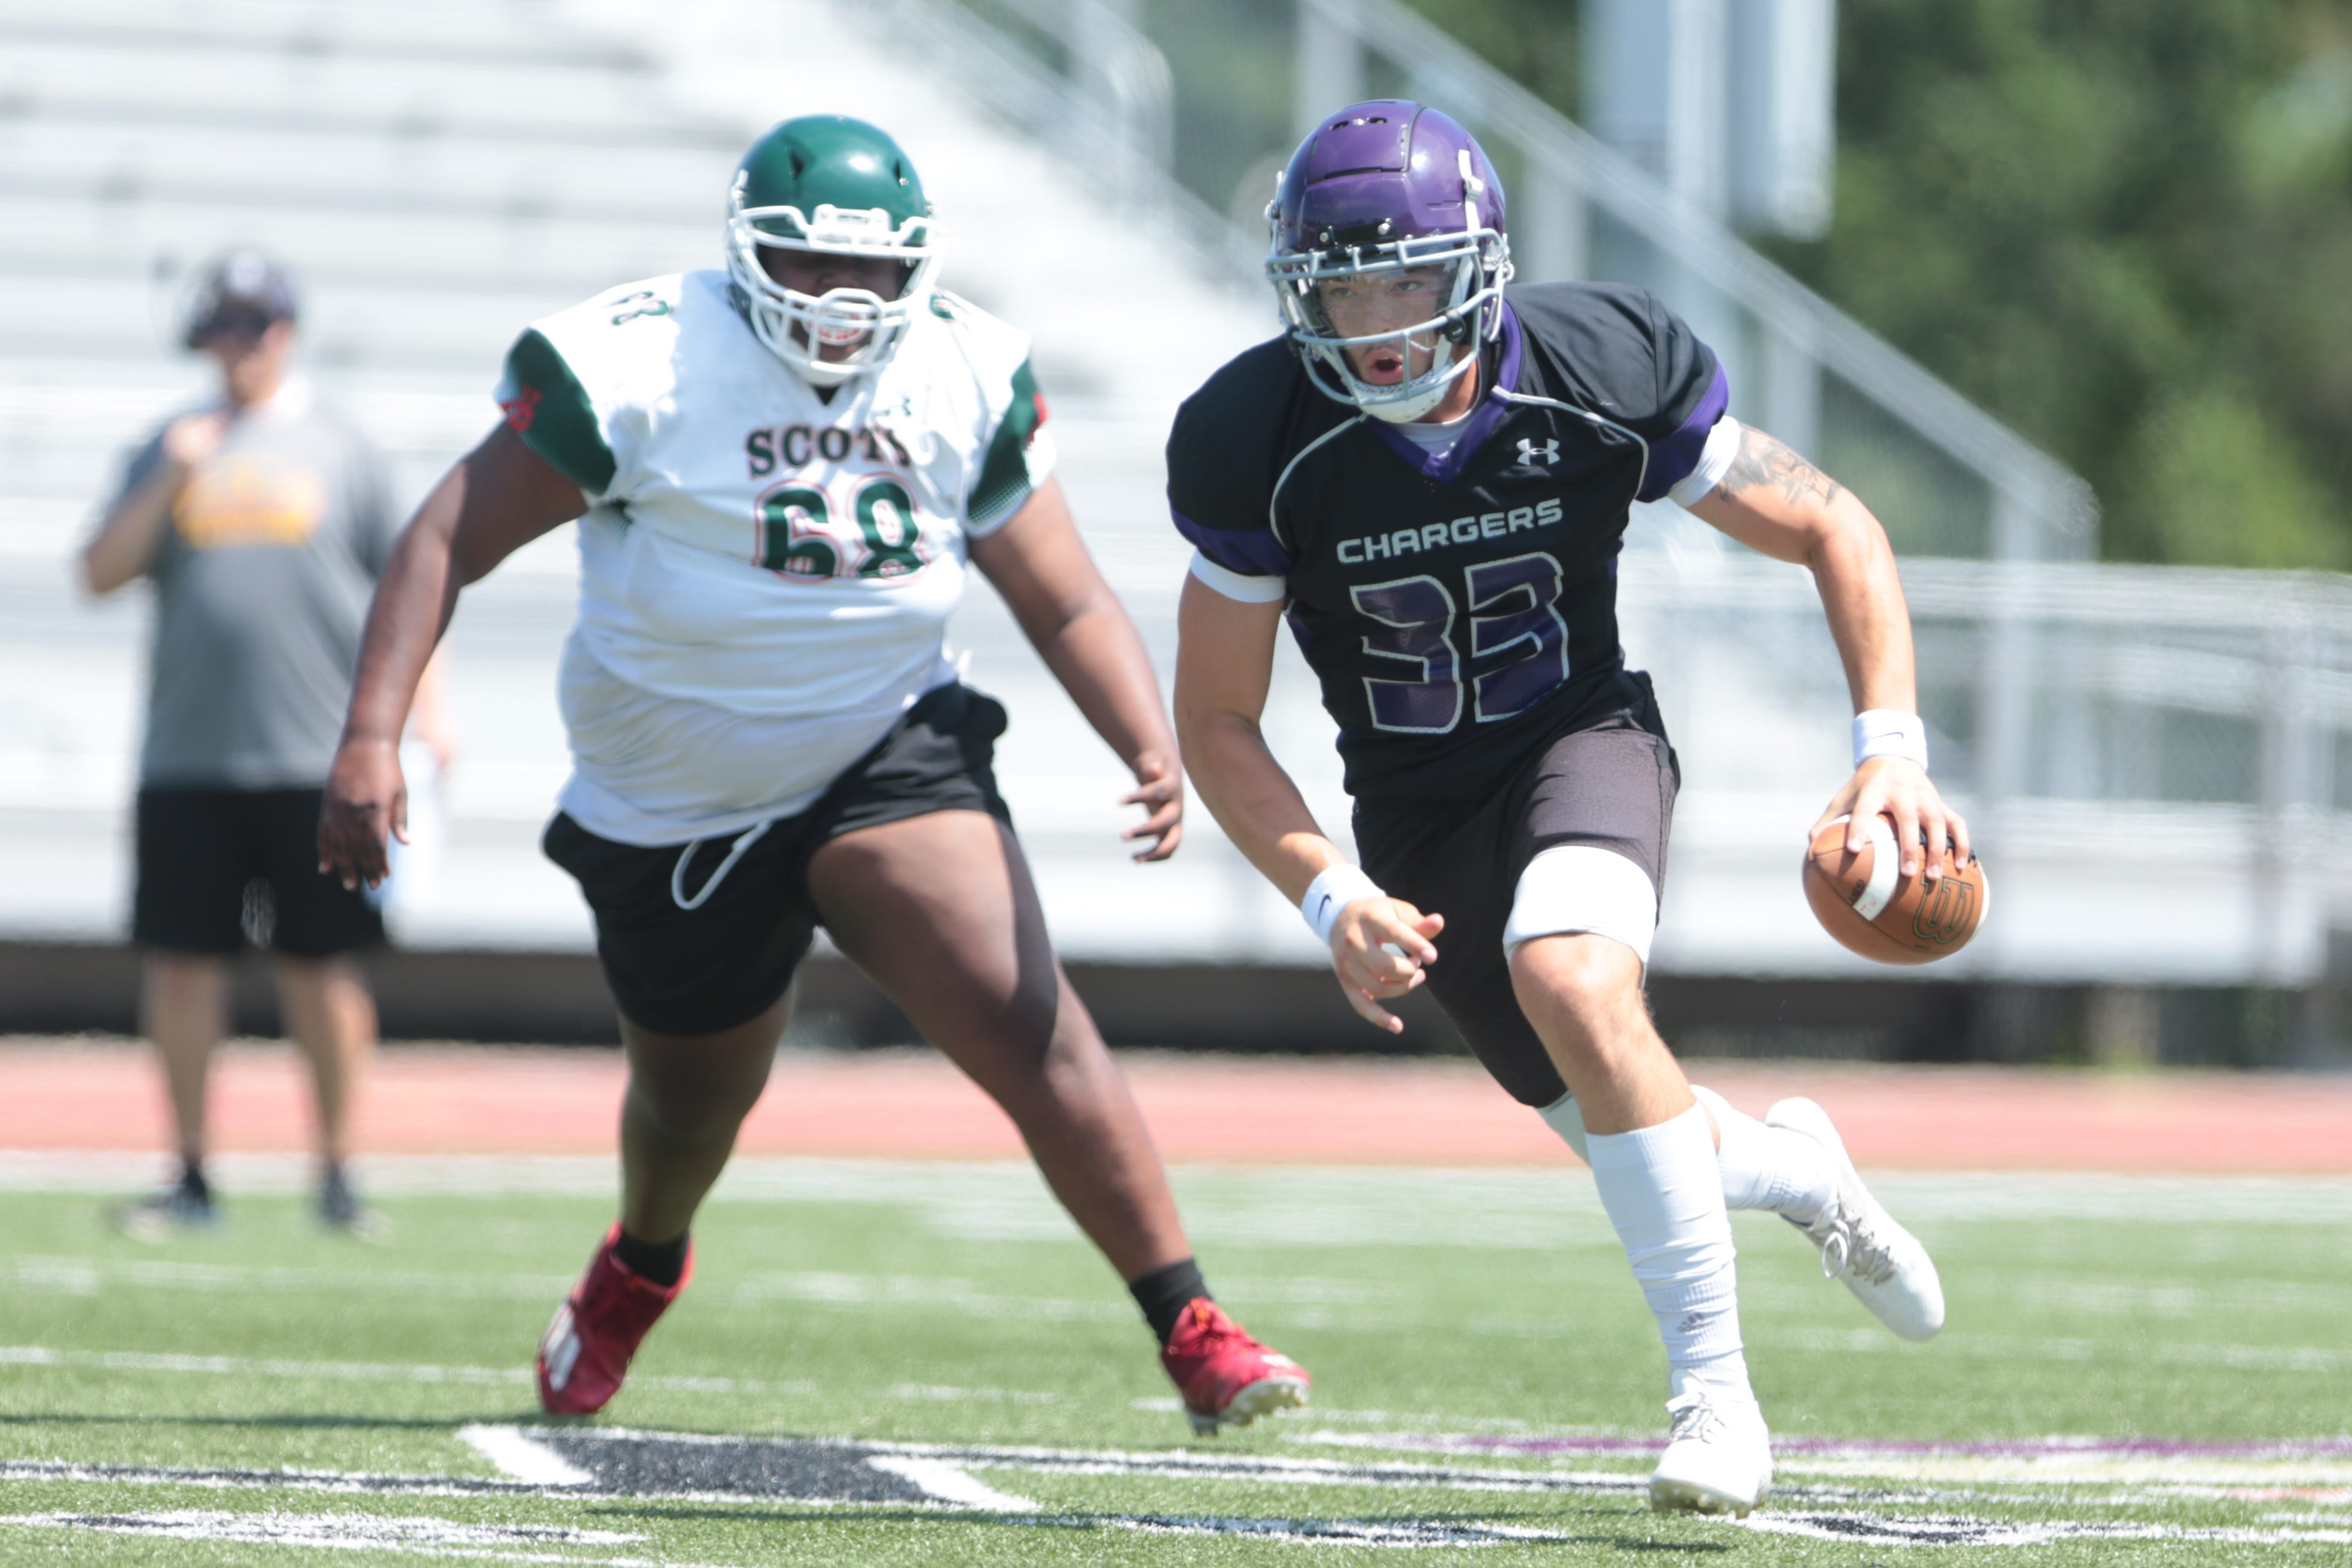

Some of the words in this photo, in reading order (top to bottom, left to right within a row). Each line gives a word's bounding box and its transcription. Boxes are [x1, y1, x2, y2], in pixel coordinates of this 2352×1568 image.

[752, 472, 931, 586] 68
[1337, 498, 1564, 564] CHARGERS
[1350, 552, 1570, 734] 33
